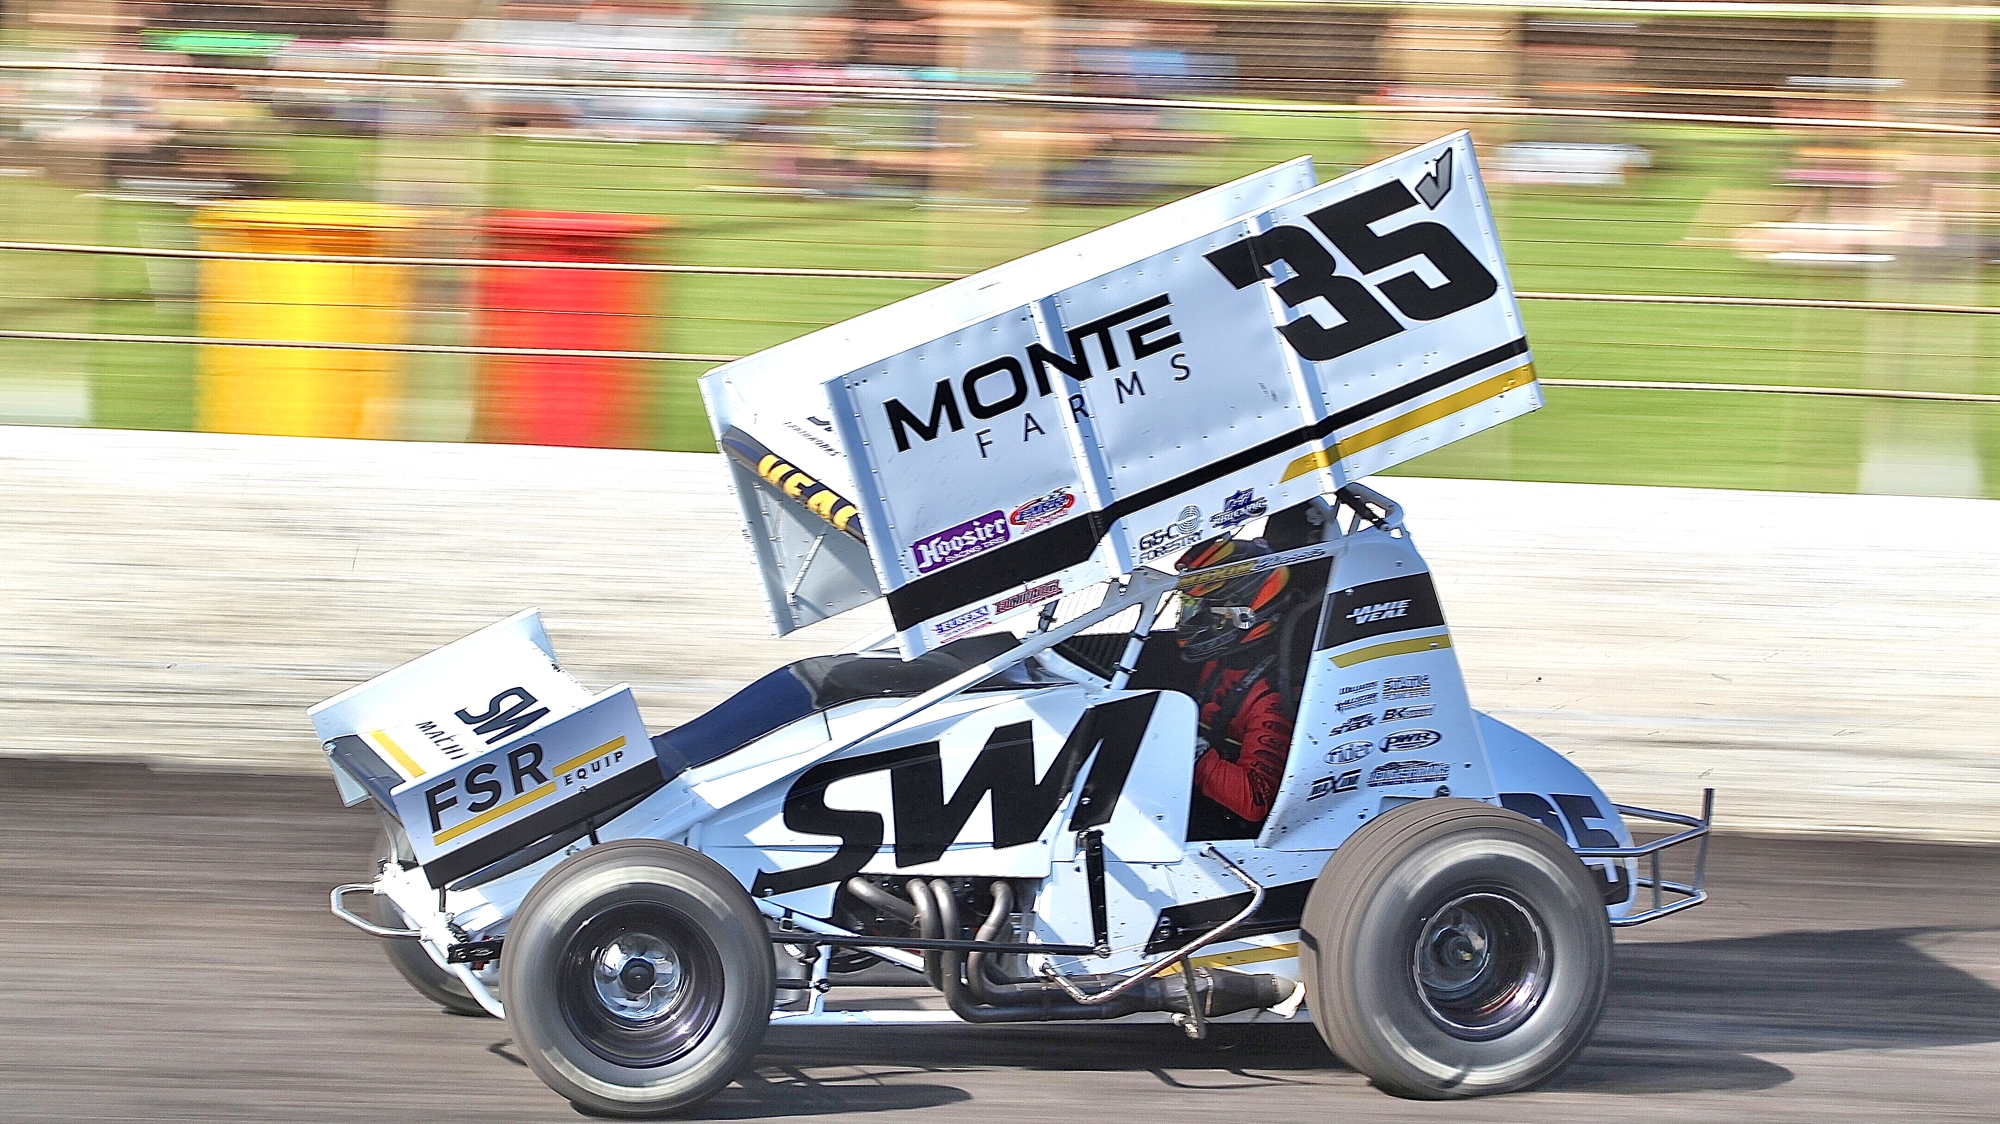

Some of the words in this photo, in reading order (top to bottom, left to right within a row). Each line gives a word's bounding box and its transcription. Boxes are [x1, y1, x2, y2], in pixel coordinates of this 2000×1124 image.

[1204, 178, 1497, 361] 35
[883, 293, 1183, 452] MONTE
[975, 353, 1192, 458] FARMS
[917, 518, 1006, 569] Hoosier
[1346, 599, 1411, 619] JAMIE
[1355, 607, 1408, 625] VEAL
[424, 742, 551, 834] FSR
[564, 750, 624, 787] EQUIP
